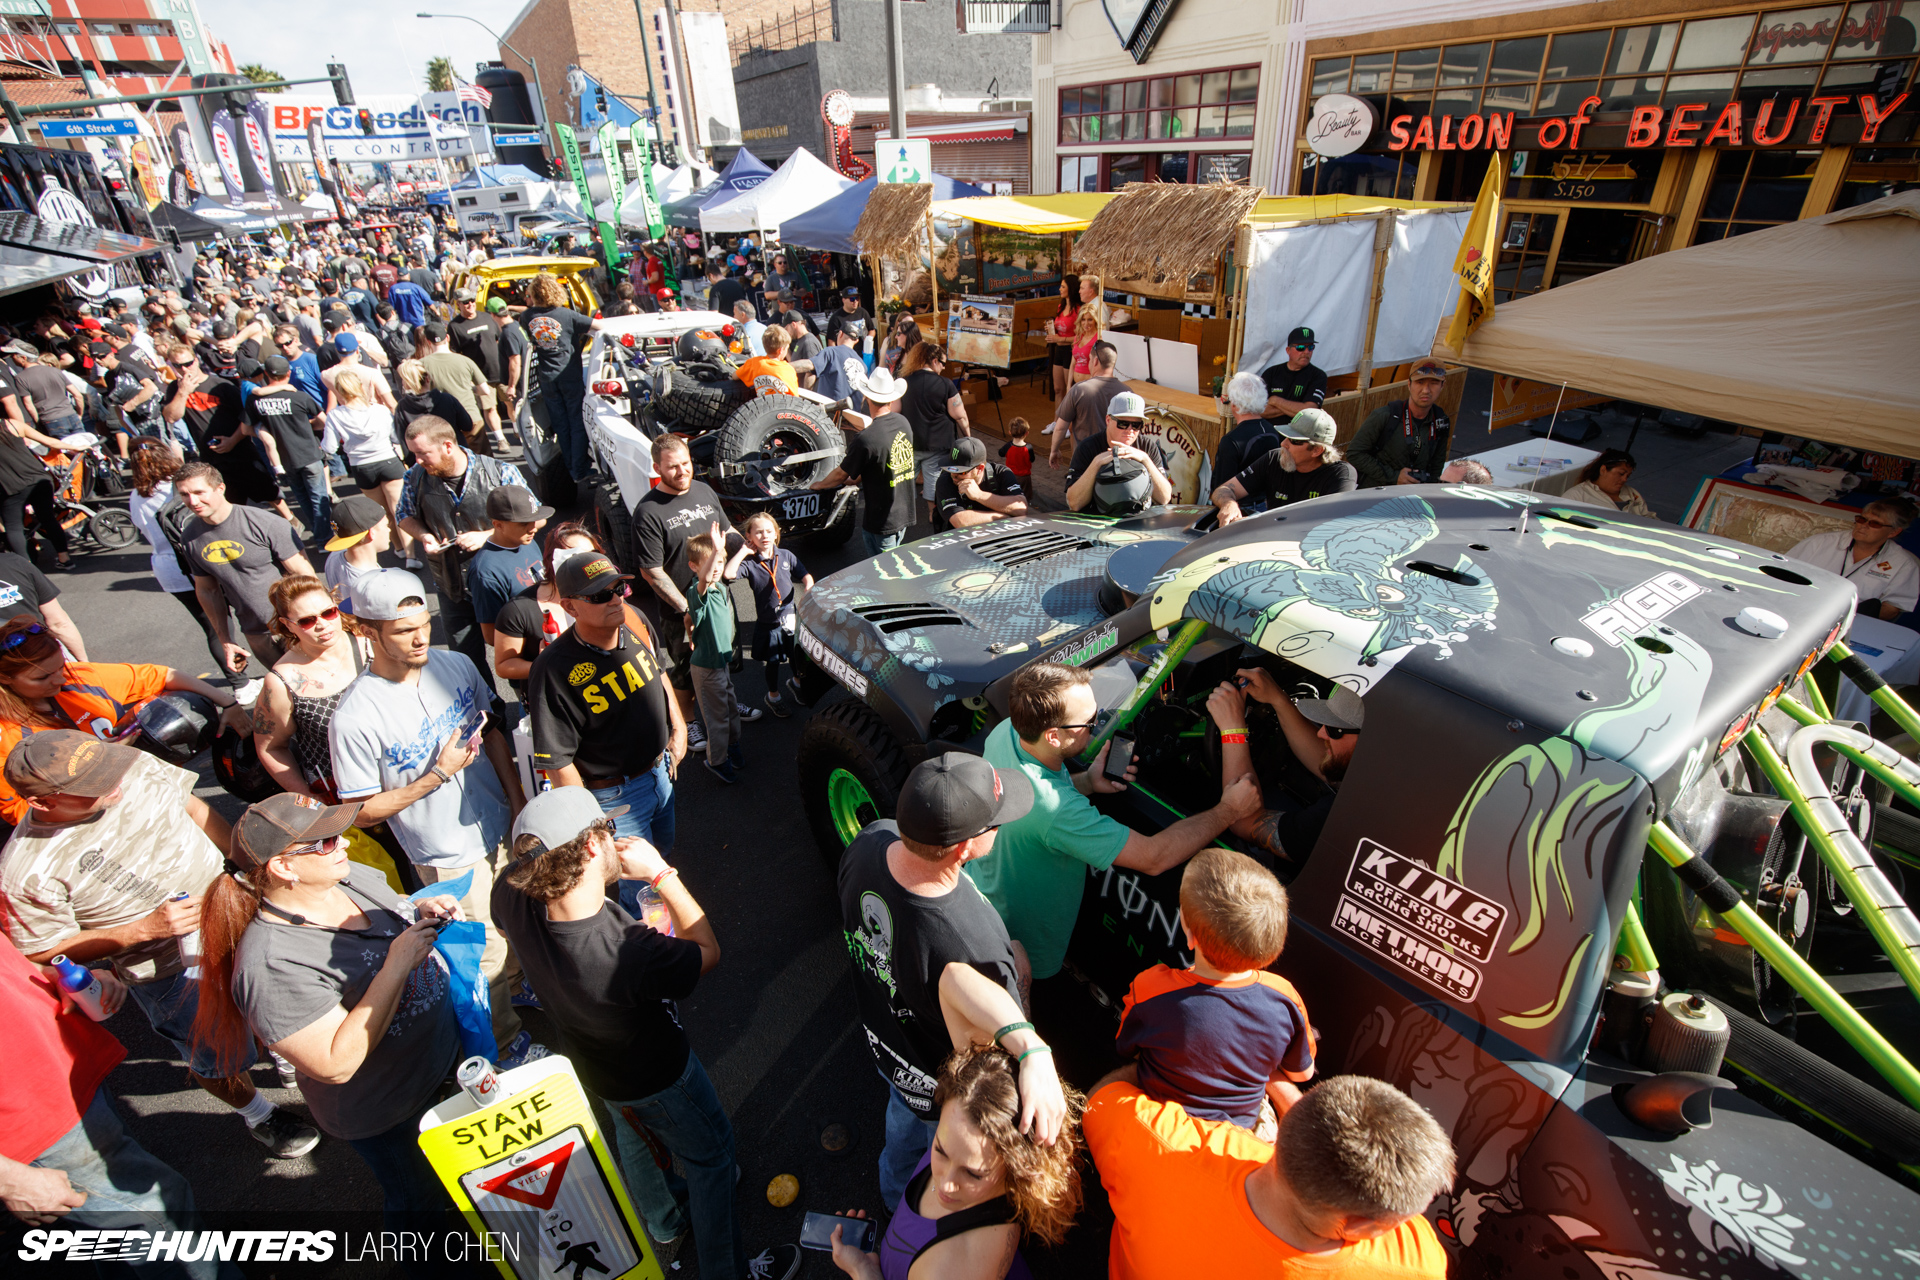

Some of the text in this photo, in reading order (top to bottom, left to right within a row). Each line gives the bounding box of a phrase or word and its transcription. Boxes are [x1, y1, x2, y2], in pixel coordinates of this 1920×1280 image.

[66, 124, 84, 134] 6th
[87, 123, 116, 133] Street
[1311, 107, 1361, 144] Beauty
[1387, 91, 1911, 151] SALON of BEAUTY
[354, 137, 464, 155] CONTROL
[1552, 154, 1612, 183] 517
[1553, 181, 1596, 200] S.150
[988, 278, 1011, 291] Pirate
[1012, 274, 1030, 285] Cove
[1032, 271, 1056, 284] Resort
[776, 412, 820, 436] GENERAL
[788, 495, 818, 519] 3710
[1579, 571, 1705, 648] RIGID
[798, 622, 869, 697] TOYO TIRES
[385, 686, 475, 768] Los Angeles
[1361, 848, 1500, 931] KING
[1373, 881, 1457, 930] OFF-ROAD
[1353, 881, 1481, 956] RACING SHOCKS
[1337, 918, 1469, 997] RACE WHEELS
[1340, 901, 1476, 988] METHOD
[452, 1091, 552, 1145] STATE
[478, 1118, 544, 1160] LAW
[517, 1169, 548, 1188] YIELD
[545, 1220, 573, 1238] TO
